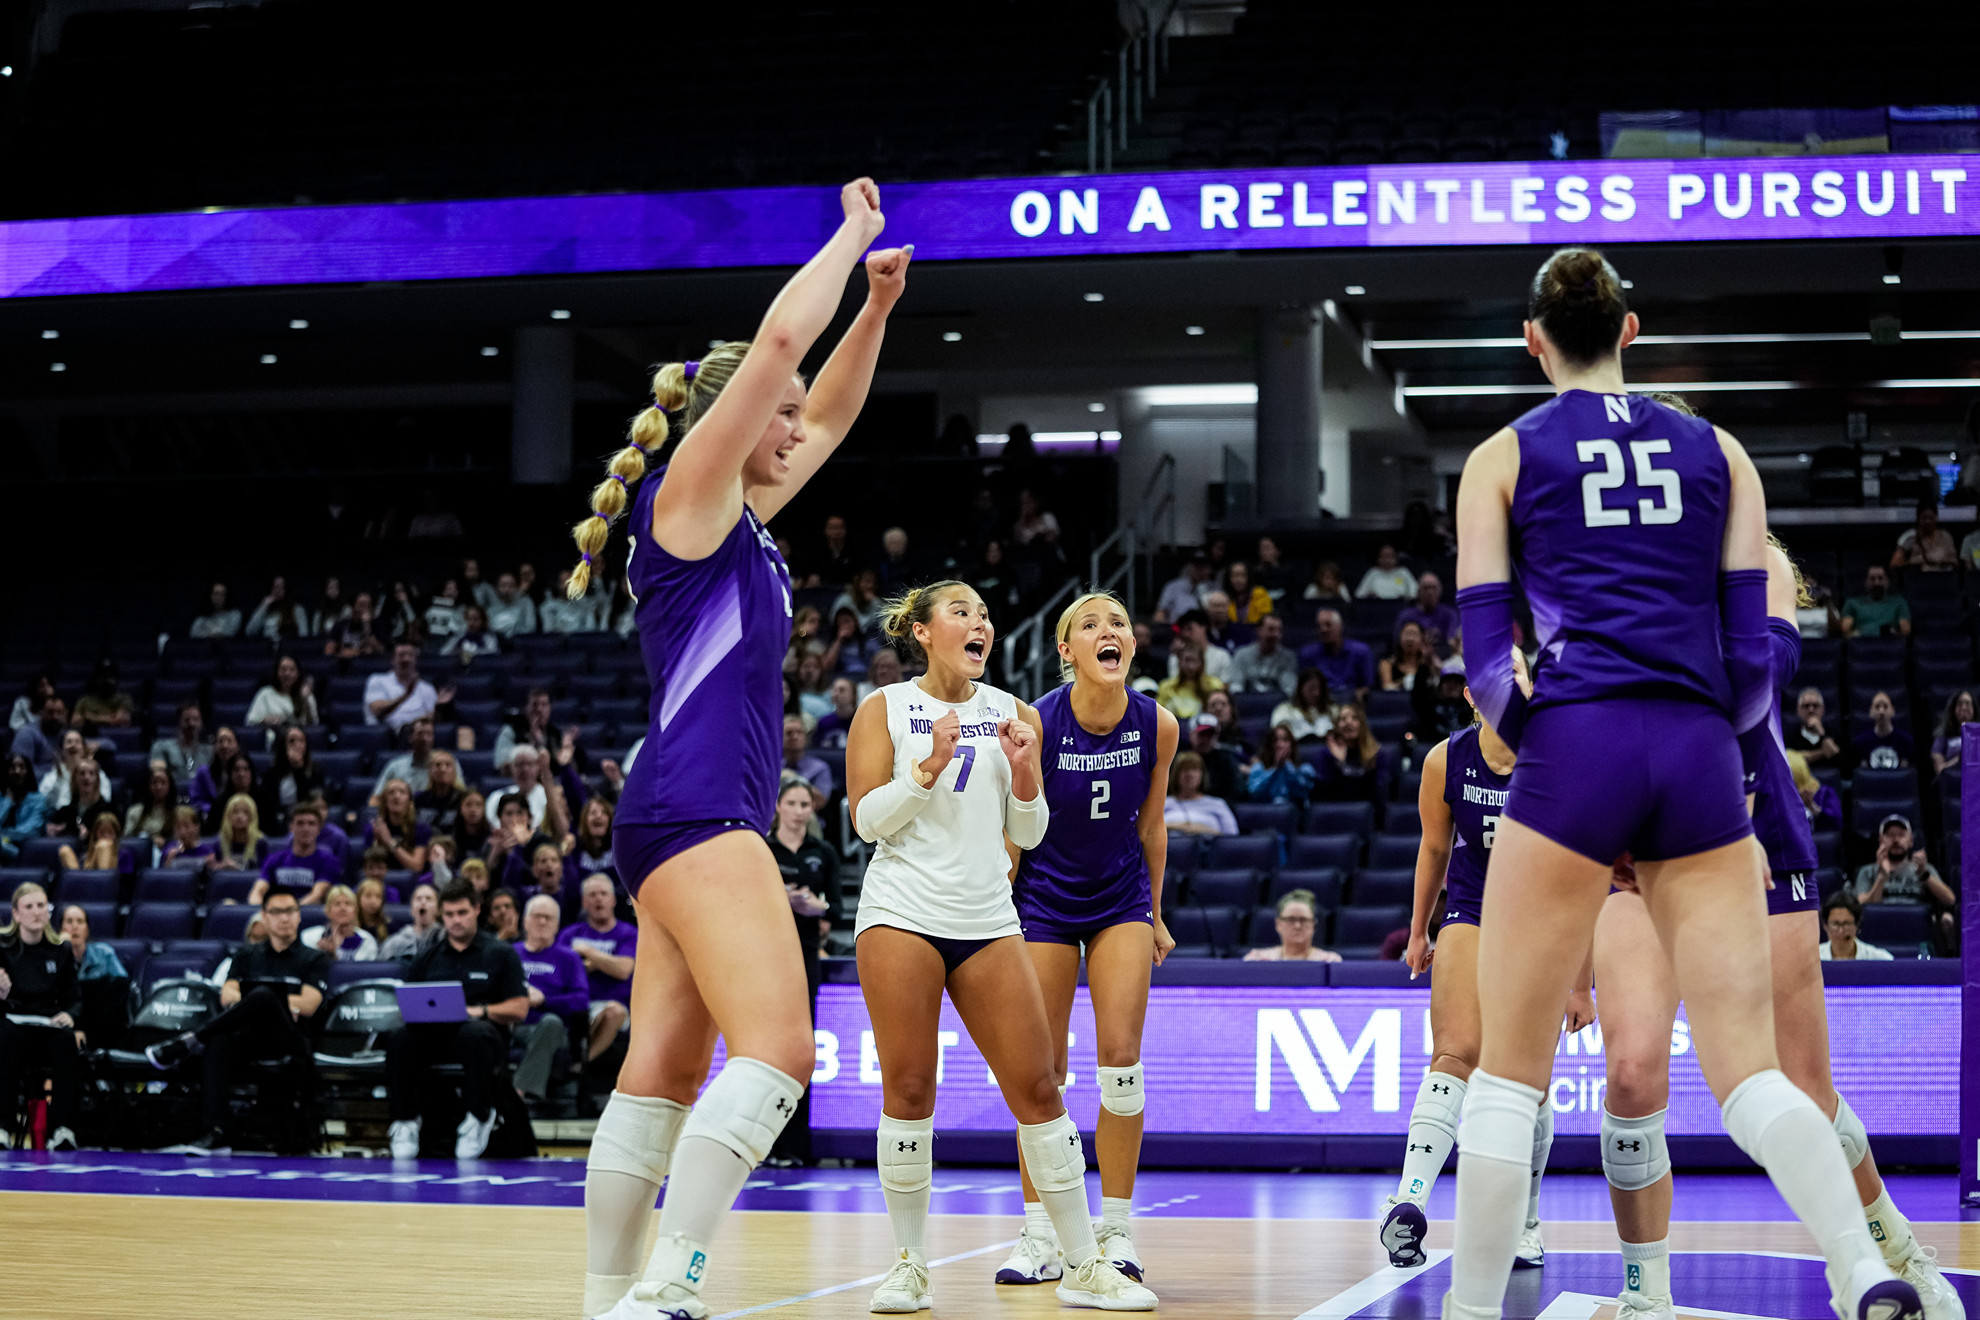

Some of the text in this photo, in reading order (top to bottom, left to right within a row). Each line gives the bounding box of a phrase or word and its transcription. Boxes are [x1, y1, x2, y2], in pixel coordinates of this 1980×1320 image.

[1010, 168, 1967, 237] ON A RELENTLESS PURSUIT
[1602, 394, 1632, 424] N
[1576, 438, 1684, 528] 25
[952, 745, 976, 793] 7
[1057, 746, 1141, 771] NORTHWESTERN
[1090, 779, 1111, 819] 2
[1791, 873, 1807, 901] N
